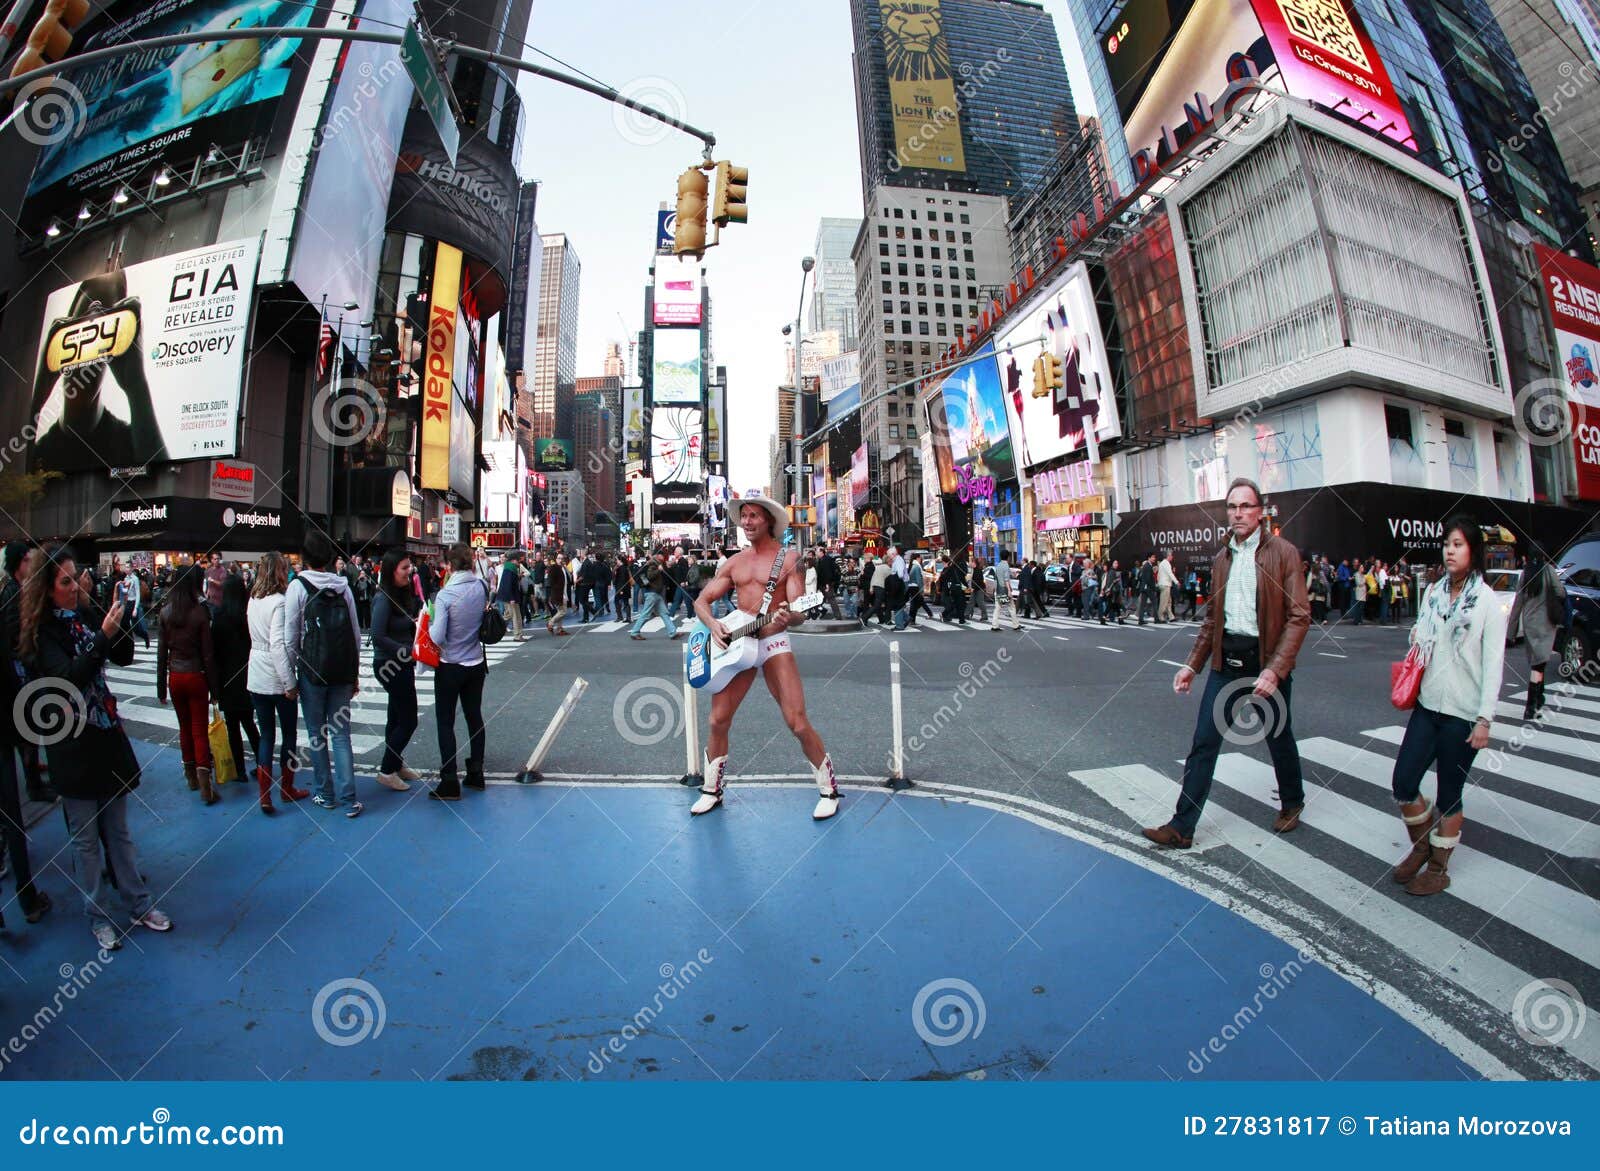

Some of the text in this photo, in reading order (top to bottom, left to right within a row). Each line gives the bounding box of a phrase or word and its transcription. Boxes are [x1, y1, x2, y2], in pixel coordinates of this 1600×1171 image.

[1116, 22, 1130, 43] LG
[1295, 44, 1314, 63] LG
[1314, 54, 1354, 84] Cinema
[913, 94, 934, 104] THE
[119, 145, 147, 164] TIMES
[148, 127, 193, 151] SQUARE
[418, 160, 508, 219] Hankook
[175, 249, 245, 271] DECLASSIFIED
[169, 263, 239, 303] CIA
[1550, 275, 1567, 301] 2
[164, 304, 234, 329] REVEALED
[60, 317, 120, 365] SPY
[157, 334, 236, 360] Discovery
[155, 355, 203, 369] TIMES SQUARE
[424, 304, 455, 424] Kodak
[181, 399, 229, 414] ONE BLOCK SOUTH
[203, 439, 226, 449] BASE
[1032, 459, 1097, 506] FOREVER
[121, 504, 168, 525] sunglass hut
[236, 511, 281, 528] sunglass hut
[1150, 527, 1213, 547] VORNADO
[1402, 541, 1430, 549] REALTY
